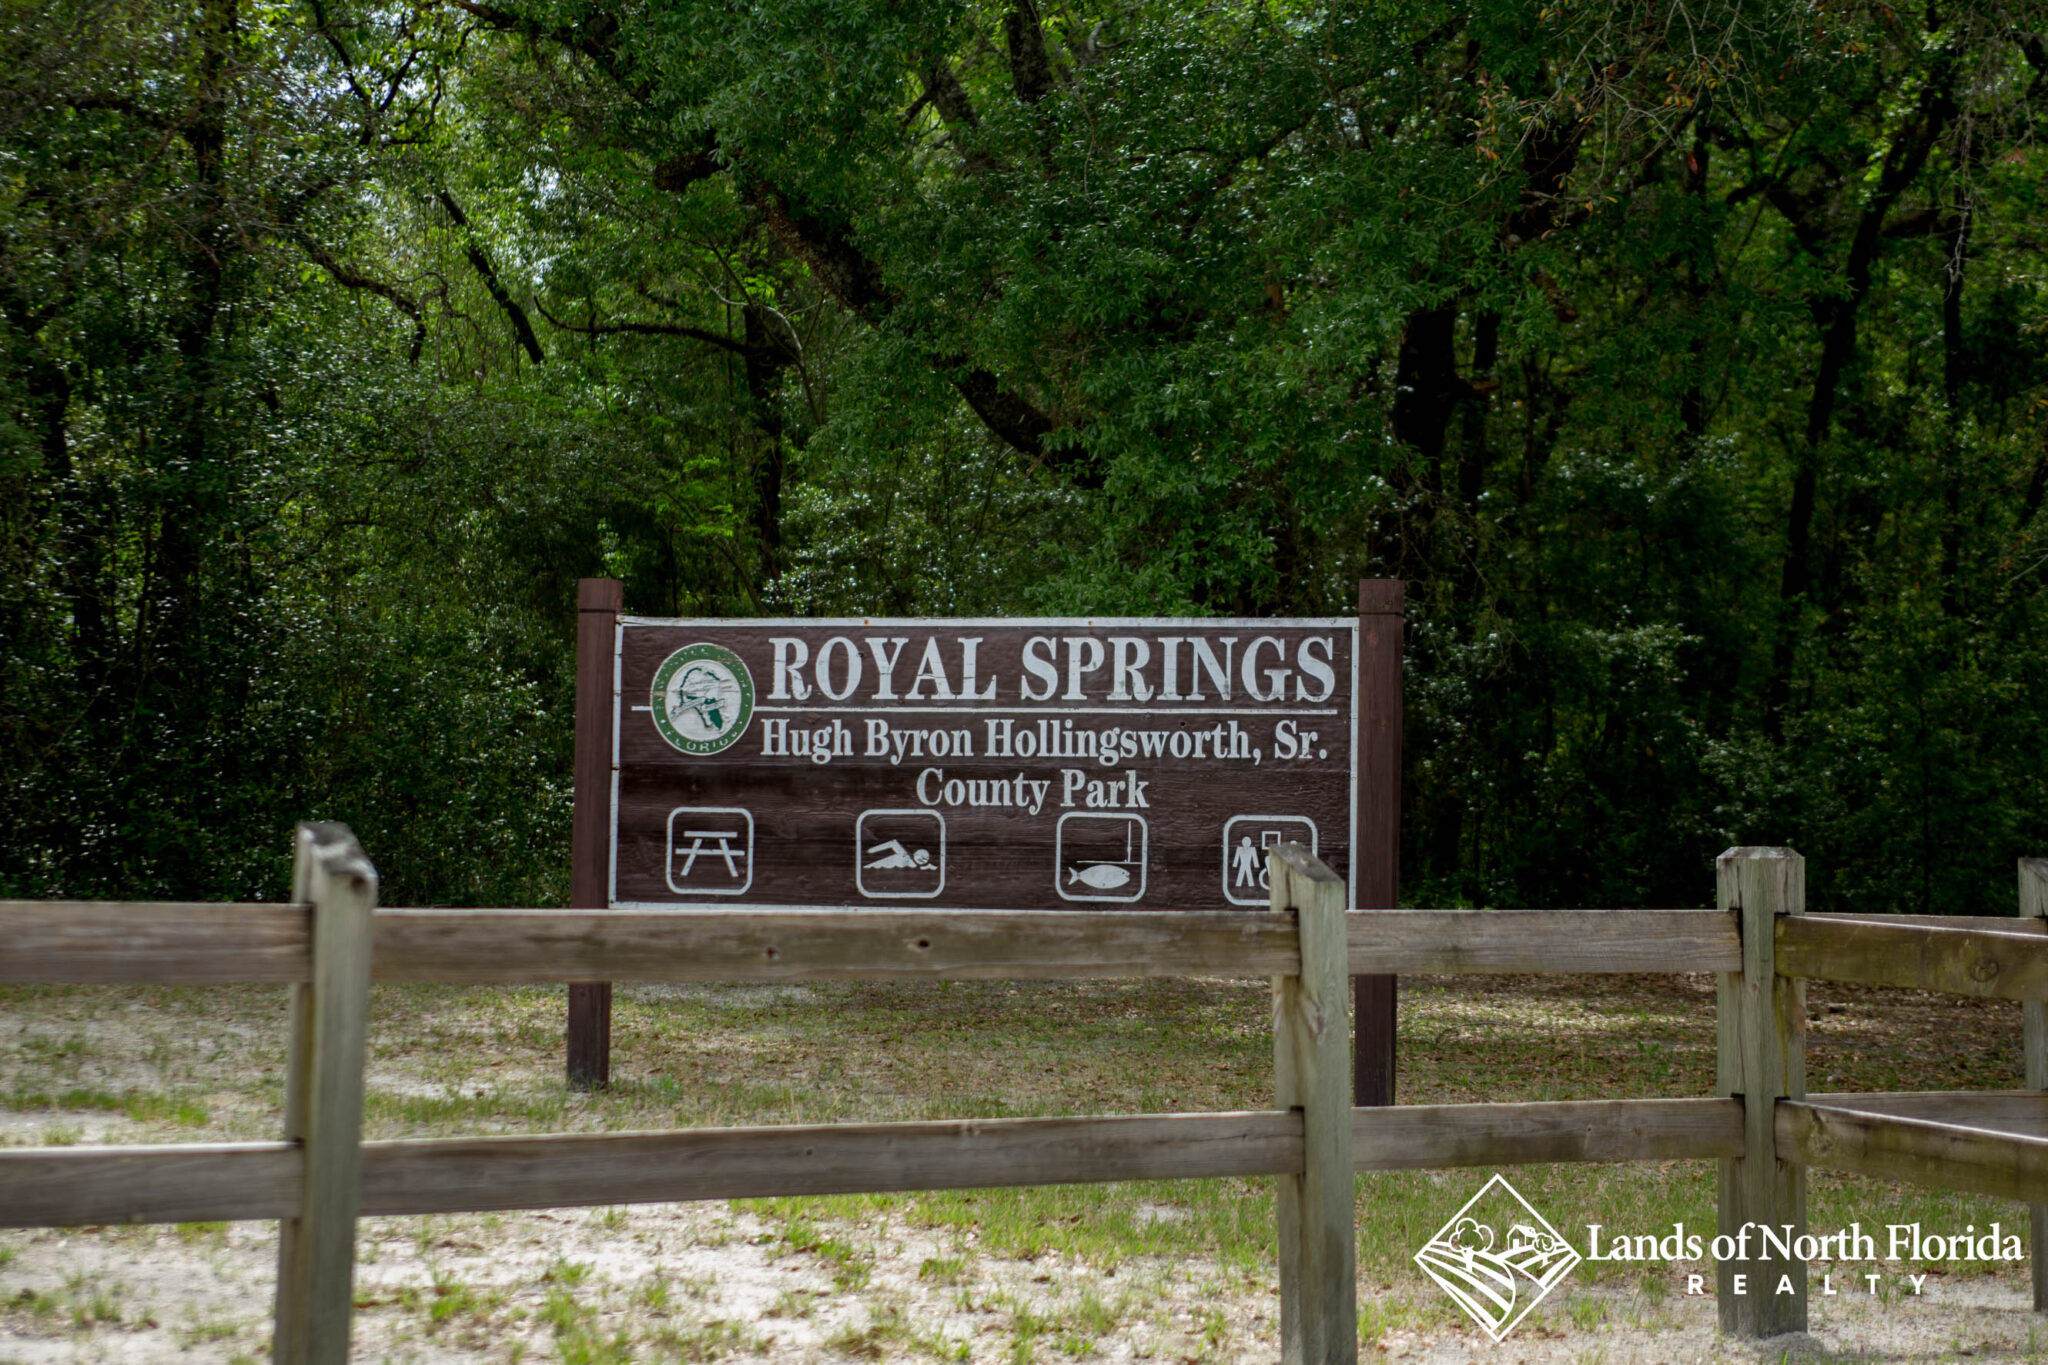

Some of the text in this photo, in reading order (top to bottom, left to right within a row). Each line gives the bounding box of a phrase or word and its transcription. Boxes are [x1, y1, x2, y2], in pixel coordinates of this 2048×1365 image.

[768, 637, 996, 700] ROYAL
[1021, 636, 1335, 702] SPRINGS
[761, 719, 1327, 766] Hugh Byron Hollingsworth, Sr.
[917, 768, 1149, 815] County Park
